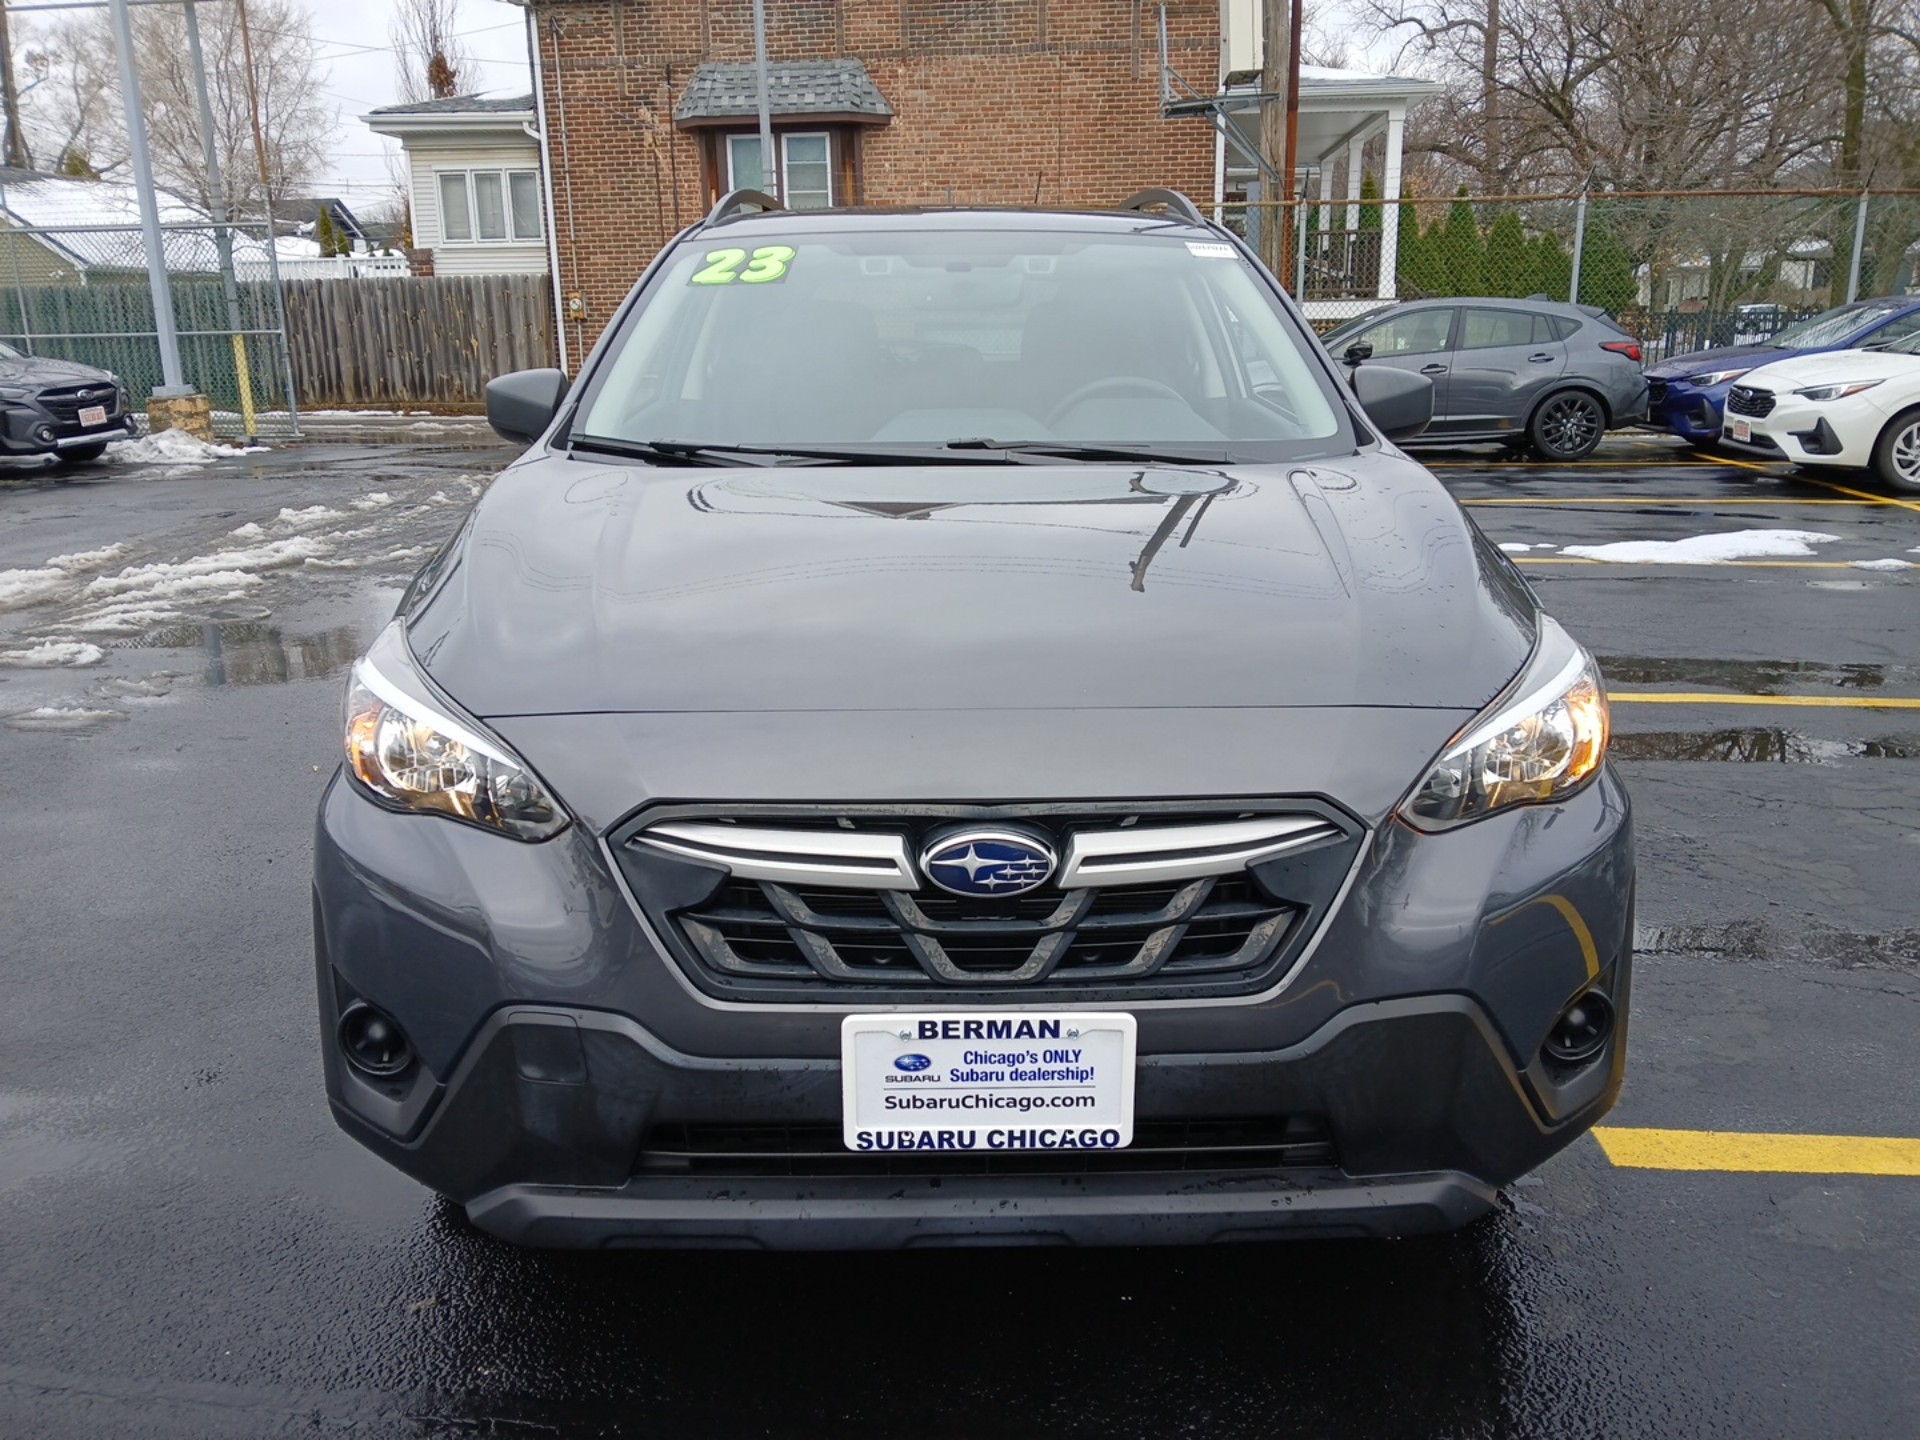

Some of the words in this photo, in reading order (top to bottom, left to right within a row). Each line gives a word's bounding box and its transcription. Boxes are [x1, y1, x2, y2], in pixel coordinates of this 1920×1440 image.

[691, 245, 796, 285] 23
[917, 1020, 1061, 1040] BERMAN
[963, 1050, 1038, 1066] Chicago's
[1042, 1049, 1082, 1064] ONLY
[885, 1074, 941, 1083] SUBARU
[950, 1068, 1005, 1083] Subaru
[1009, 1066, 1095, 1084] dealership!
[884, 1094, 1096, 1112] SubaruChicago.com
[856, 1130, 976, 1150] SUBARU
[986, 1128, 1121, 1149] CHICAGO
